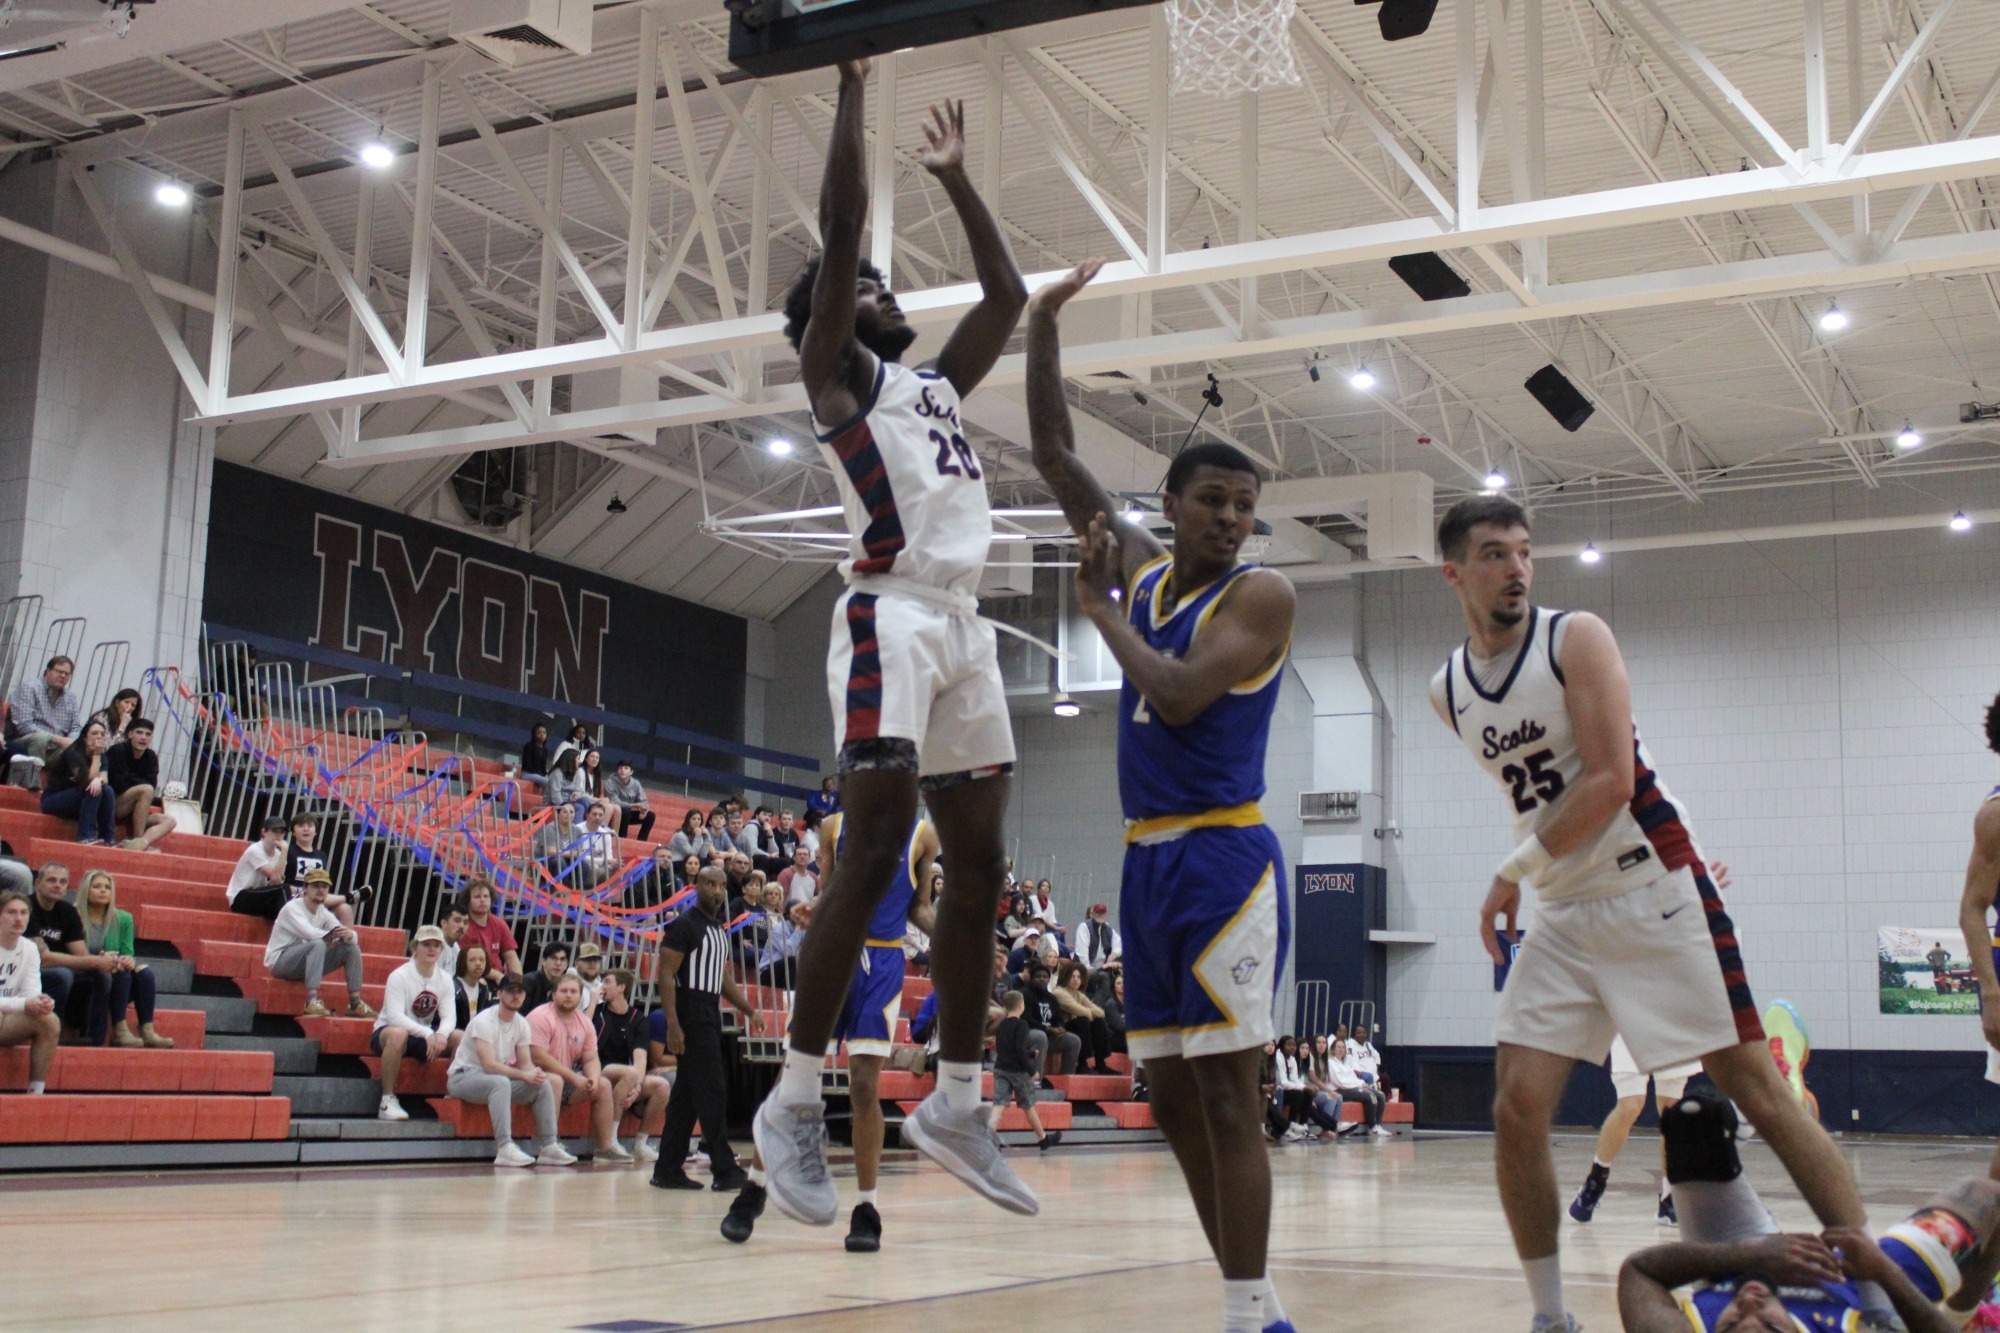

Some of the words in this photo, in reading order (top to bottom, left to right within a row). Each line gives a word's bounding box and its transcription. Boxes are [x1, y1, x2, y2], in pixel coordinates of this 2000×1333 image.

[928, 428, 981, 480] 20
[305, 512, 610, 735] LYON
[1482, 718, 1547, 760] Scots
[1502, 748, 1566, 815] 25
[1304, 873, 1355, 894] LYON
[1908, 1000, 1953, 1010] Welcome
